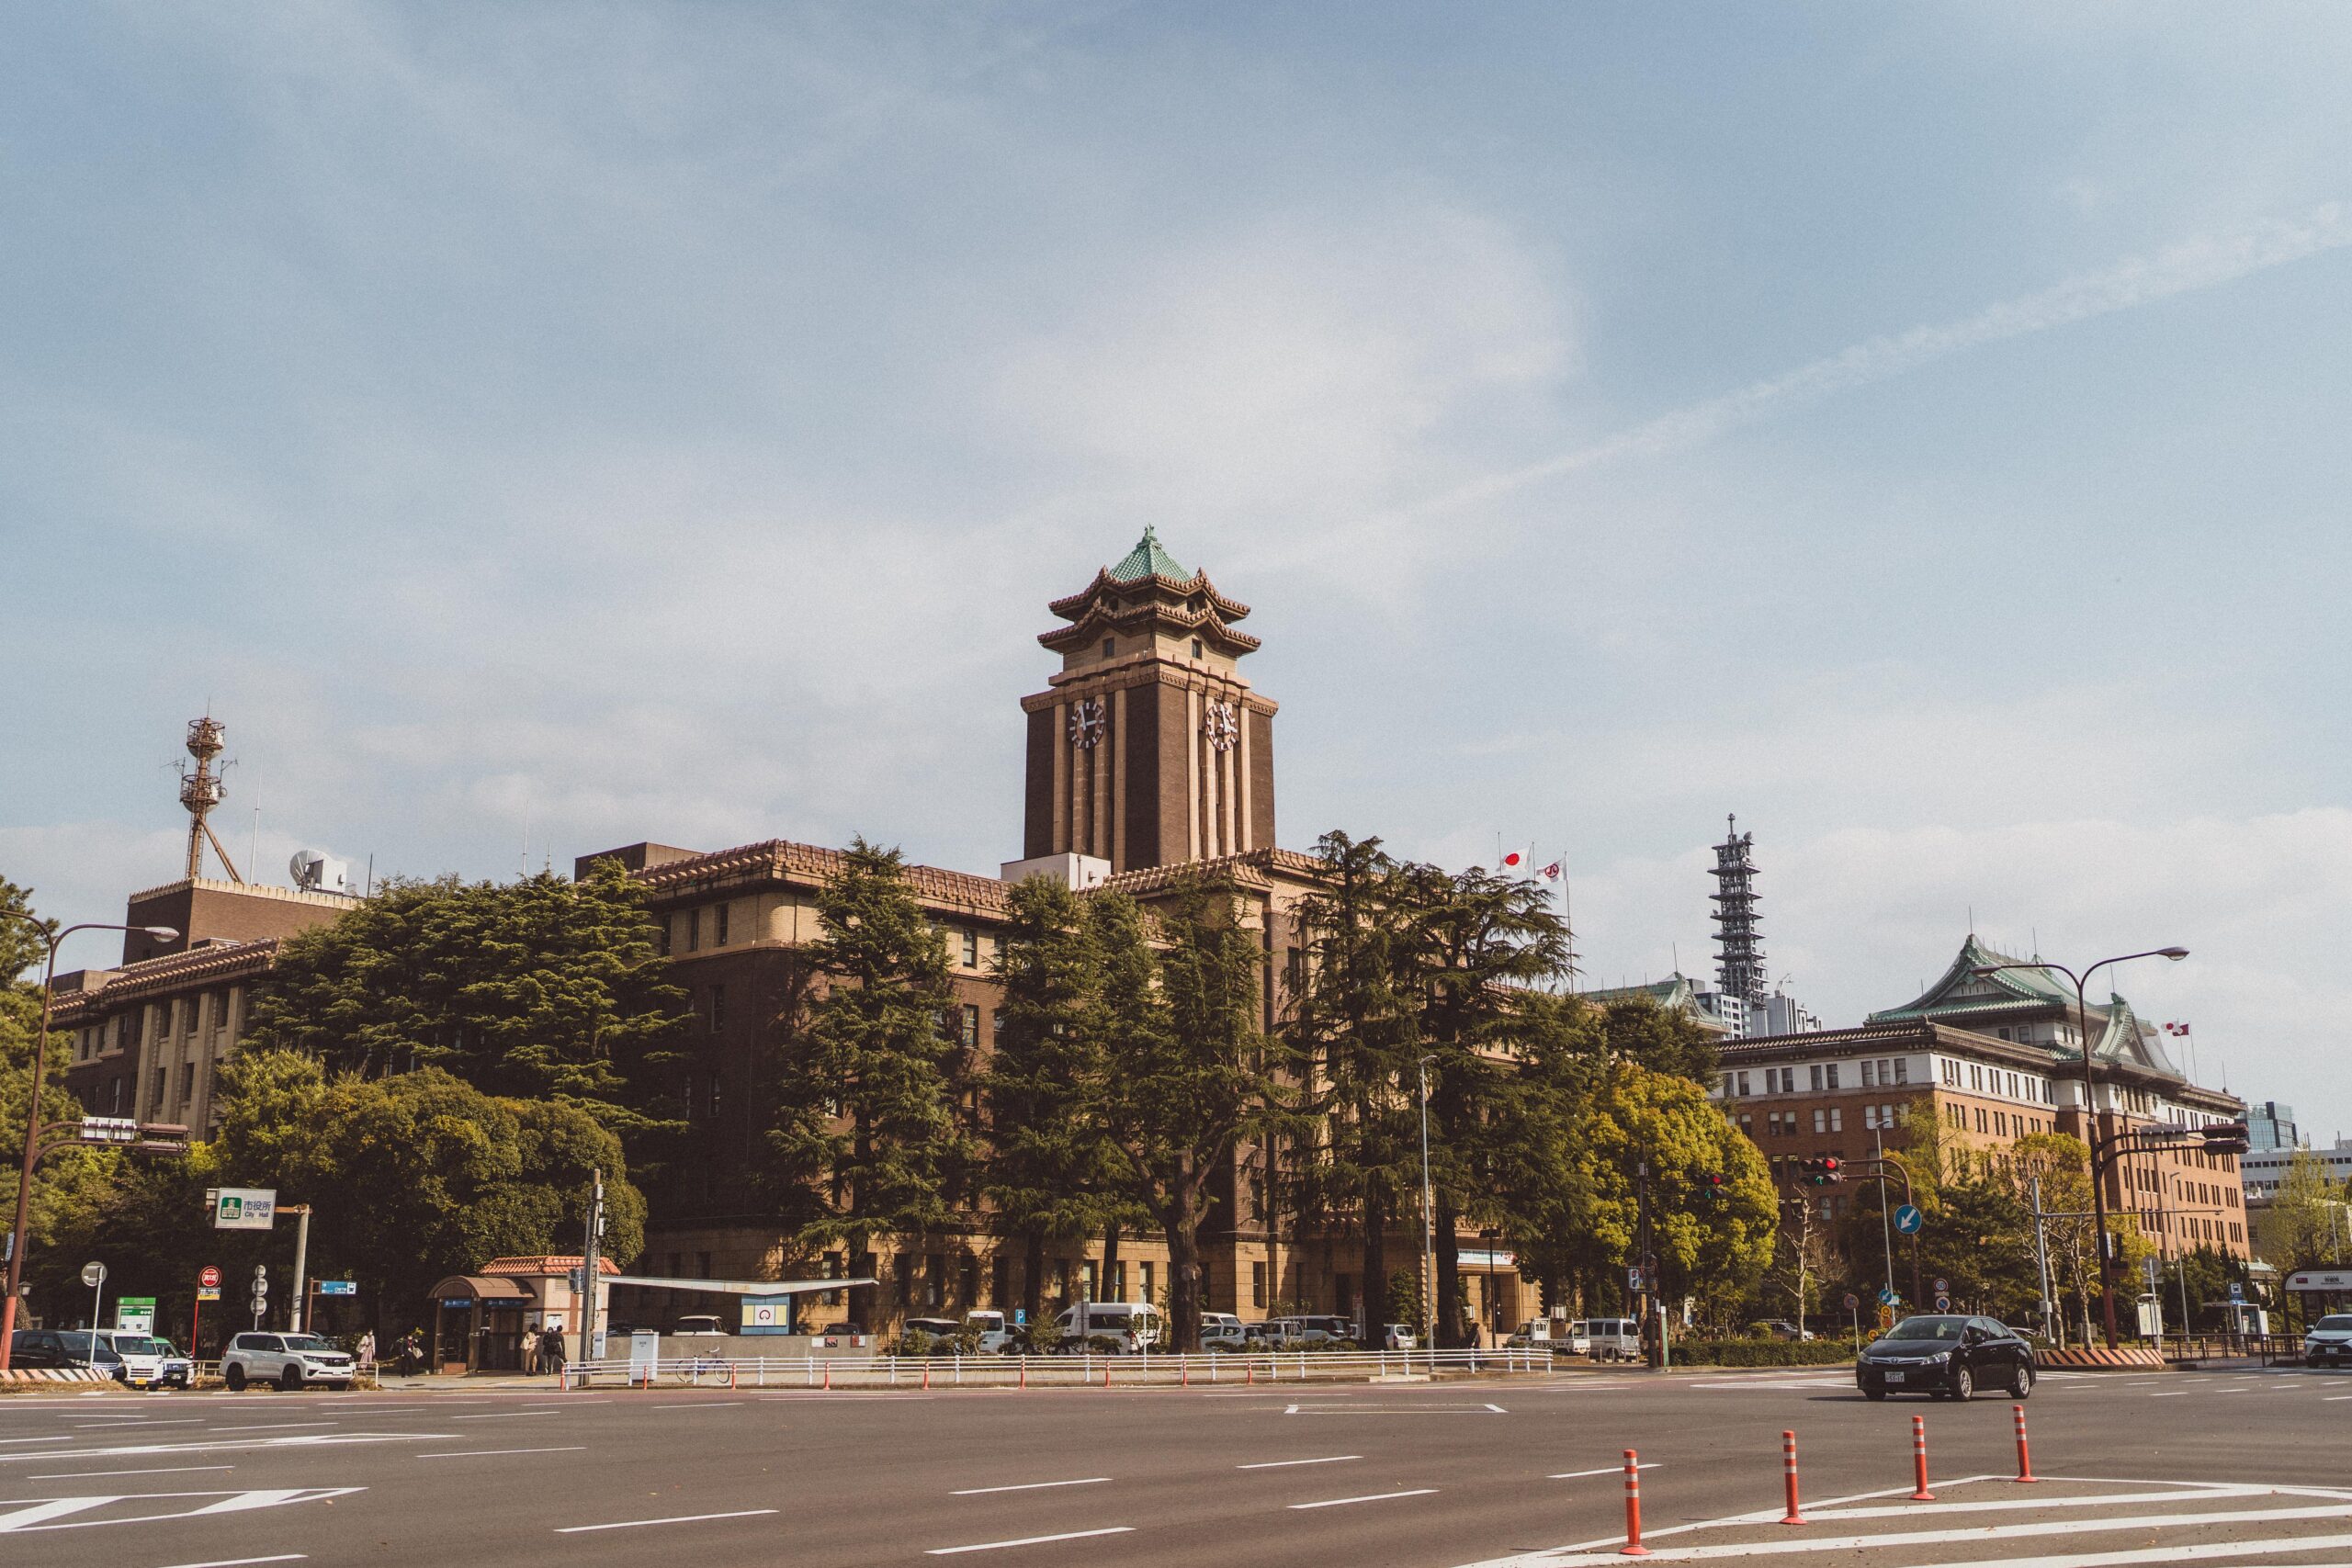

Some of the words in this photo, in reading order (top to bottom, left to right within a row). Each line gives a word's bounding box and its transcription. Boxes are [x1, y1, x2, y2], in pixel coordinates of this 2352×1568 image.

[243, 1201, 271, 1211] 市役所
[1017, 1311, 1023, 1322] P
